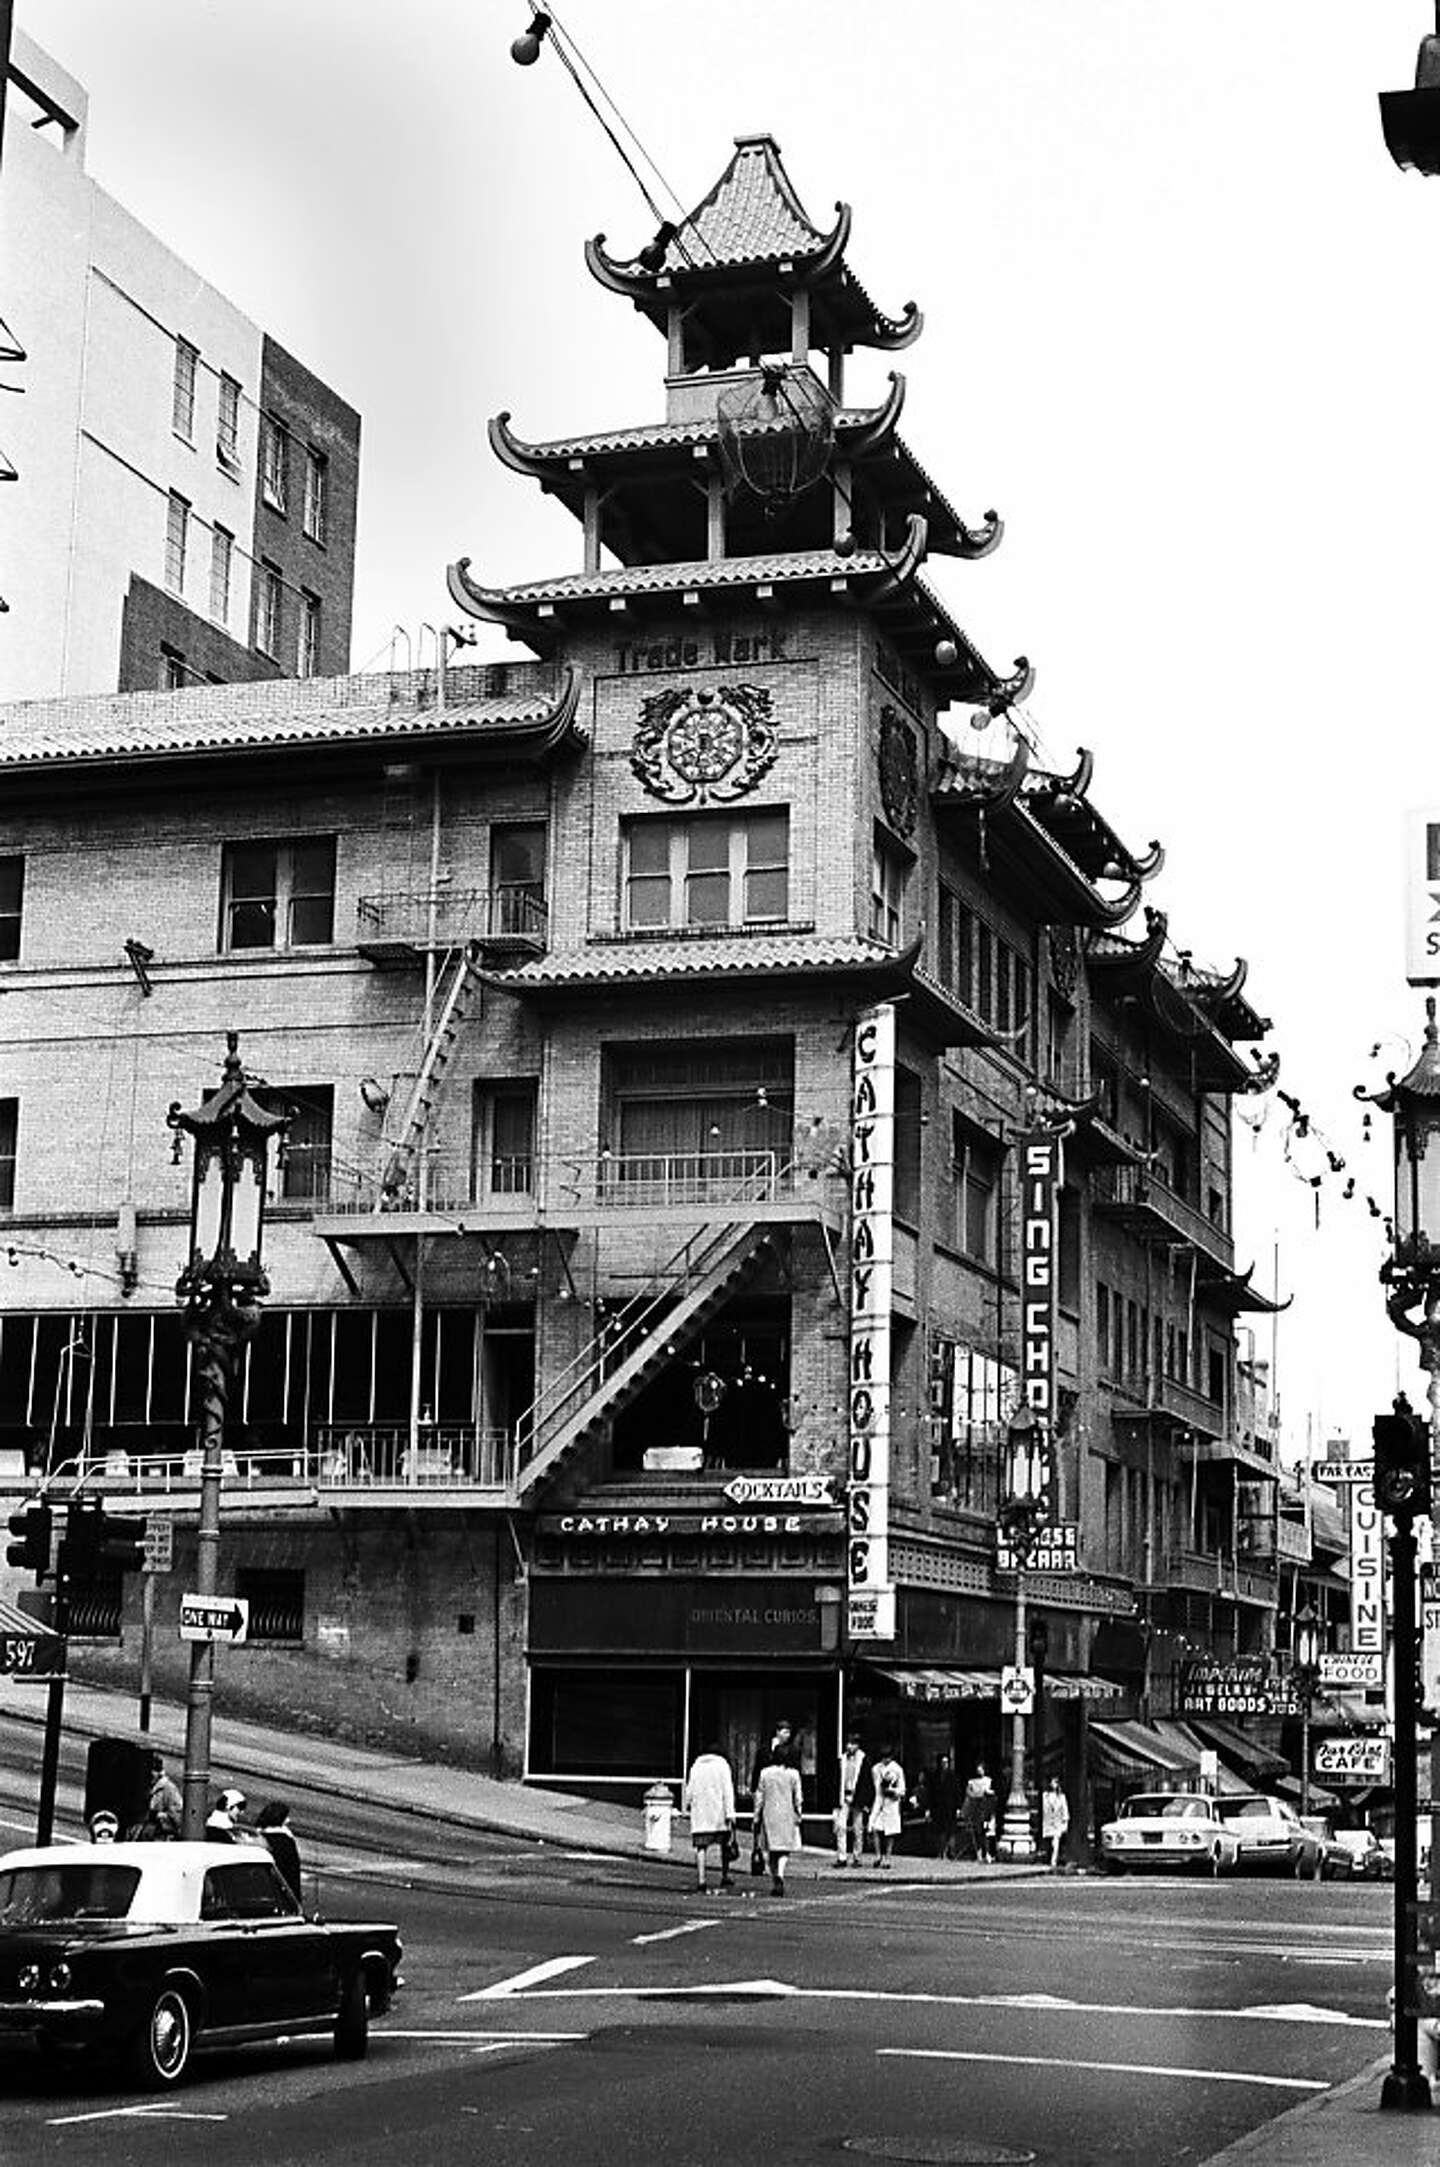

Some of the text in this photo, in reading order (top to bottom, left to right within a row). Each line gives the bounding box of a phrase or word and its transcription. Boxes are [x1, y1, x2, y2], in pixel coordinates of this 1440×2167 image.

[854, 1025, 877, 1311] CATHAY
[1027, 1146, 1051, 1285] SING
[850, 1336, 874, 1585] HOUSE
[1319, 1465, 1375, 1478] FAR EAS
[730, 1481, 823, 1500] COCKTAILS
[561, 1516, 801, 1532] CATHAY HOUSE
[997, 1549, 1078, 1569] BAZAAR
[1358, 1488, 1377, 1646] CUISINE
[184, 1609, 229, 1629] ONE WAY
[691, 1608, 761, 1624] ORIENTAL
[6, 1640, 36, 1667] 597
[1323, 1666, 1377, 1680] FOOD
[1184, 1697, 1213, 1712] ART
[1217, 1697, 1266, 1712] GOODS
[1320, 1756, 1376, 1770] CAFE
